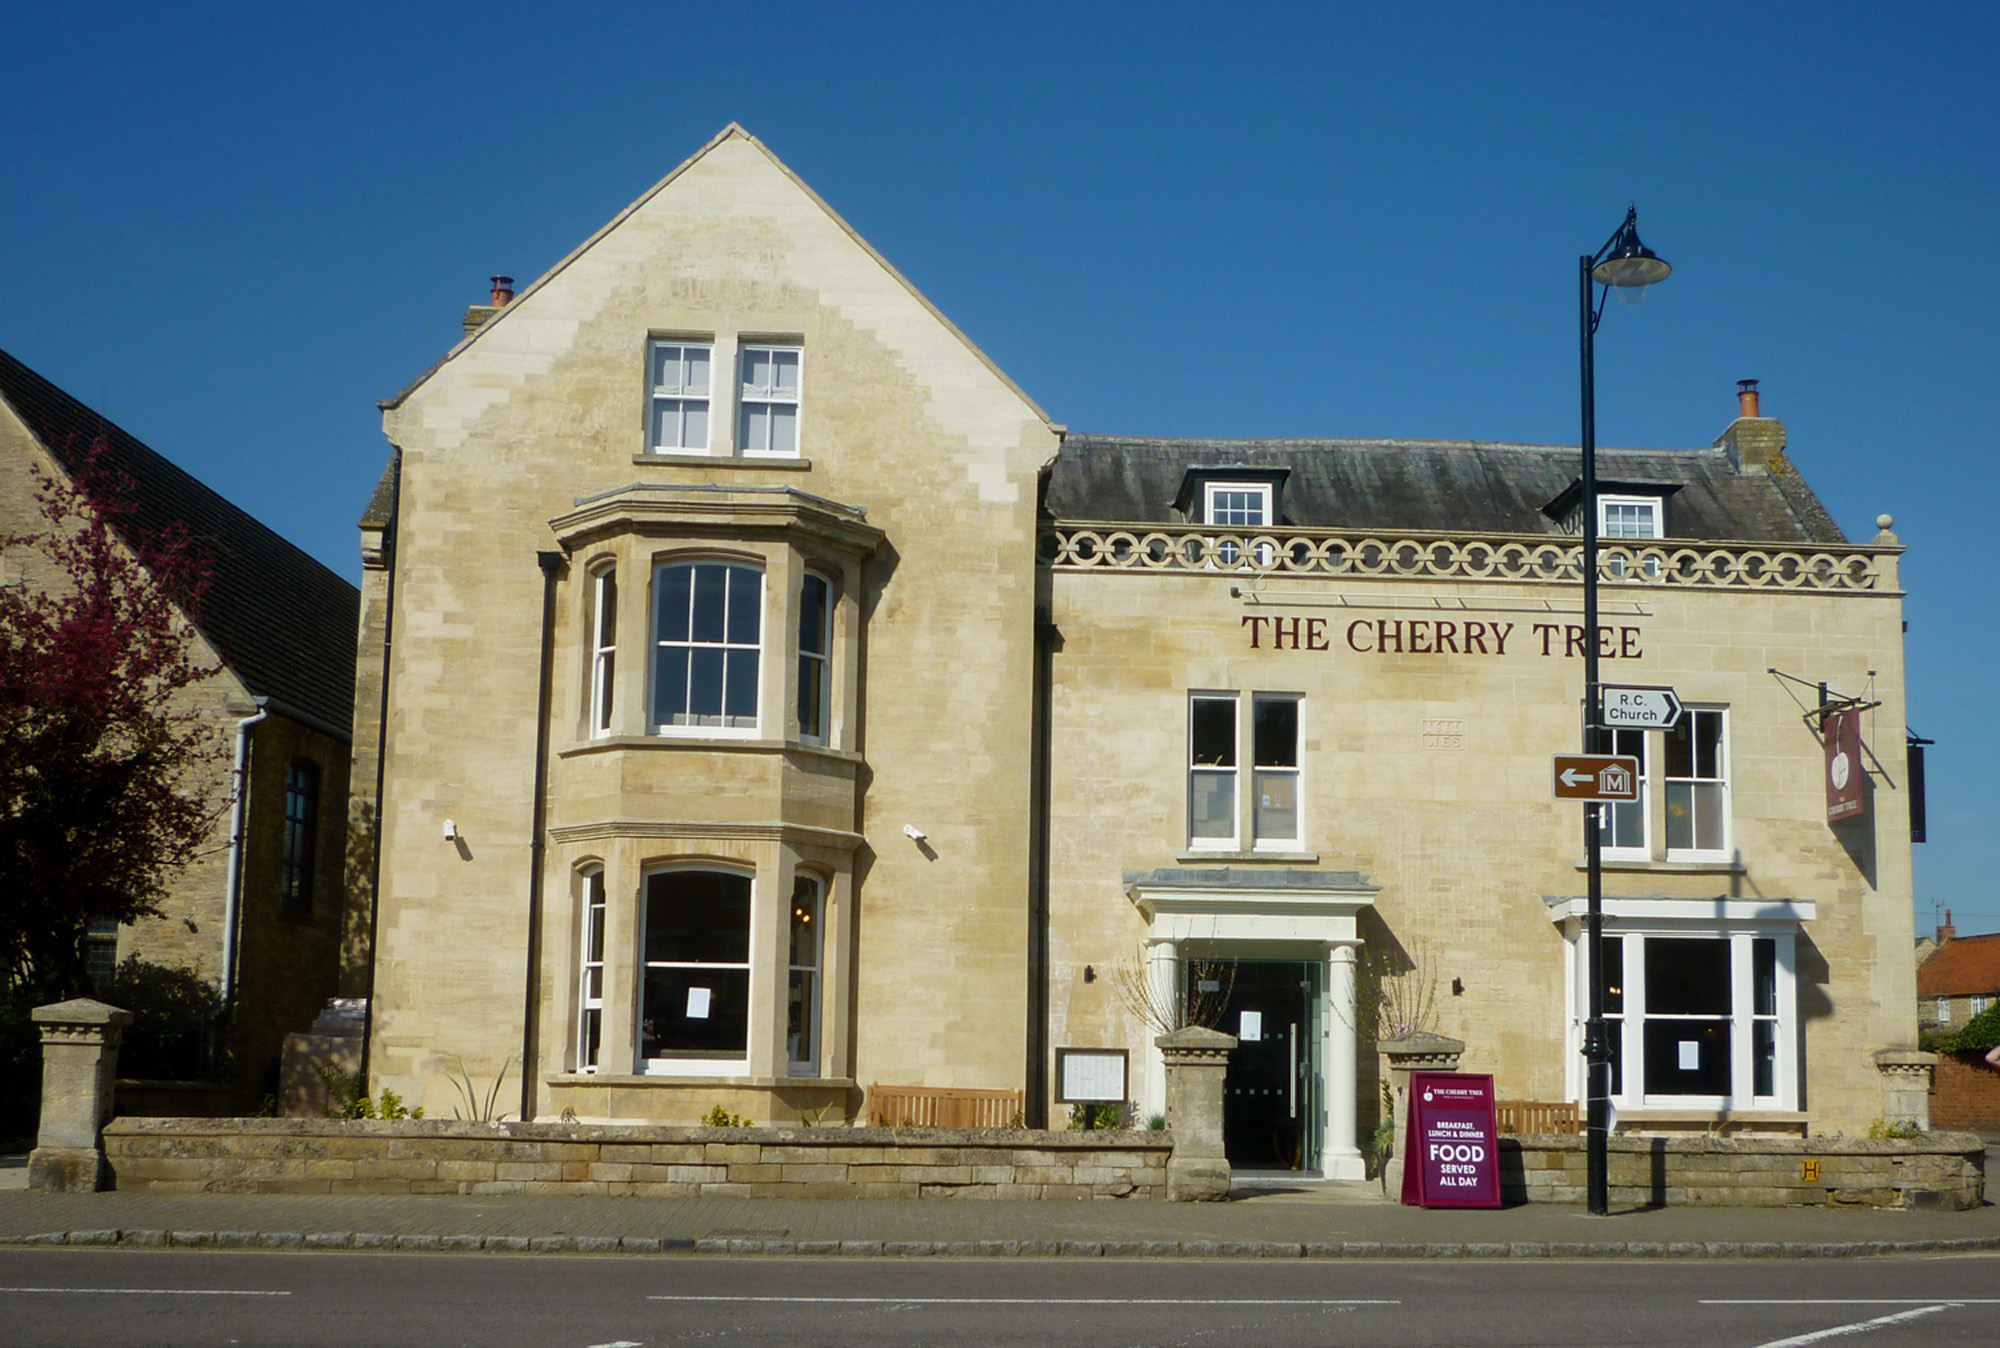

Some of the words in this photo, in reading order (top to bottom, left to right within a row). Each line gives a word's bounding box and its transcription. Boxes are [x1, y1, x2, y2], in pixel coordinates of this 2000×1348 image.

[1241, 615, 1330, 651] THE
[1346, 619, 1515, 655] CHERRY
[1532, 623, 1643, 659] TREE
[1620, 694, 1648, 706] R.C.
[1609, 708, 1657, 720] Church
[1607, 774, 1623, 791] M
[1436, 1121, 1475, 1130] BREAKFAST,
[1428, 1130, 1452, 1138] LUNCH
[1453, 1130, 1458, 1138] &
[1459, 1130, 1484, 1138] DINNER
[1430, 1144, 1485, 1162] FOOD
[1440, 1164, 1476, 1174] SERVED
[1804, 1161, 1817, 1178] H
[1439, 1176, 1457, 1186] ALL
[1458, 1177, 1478, 1187] DAY
